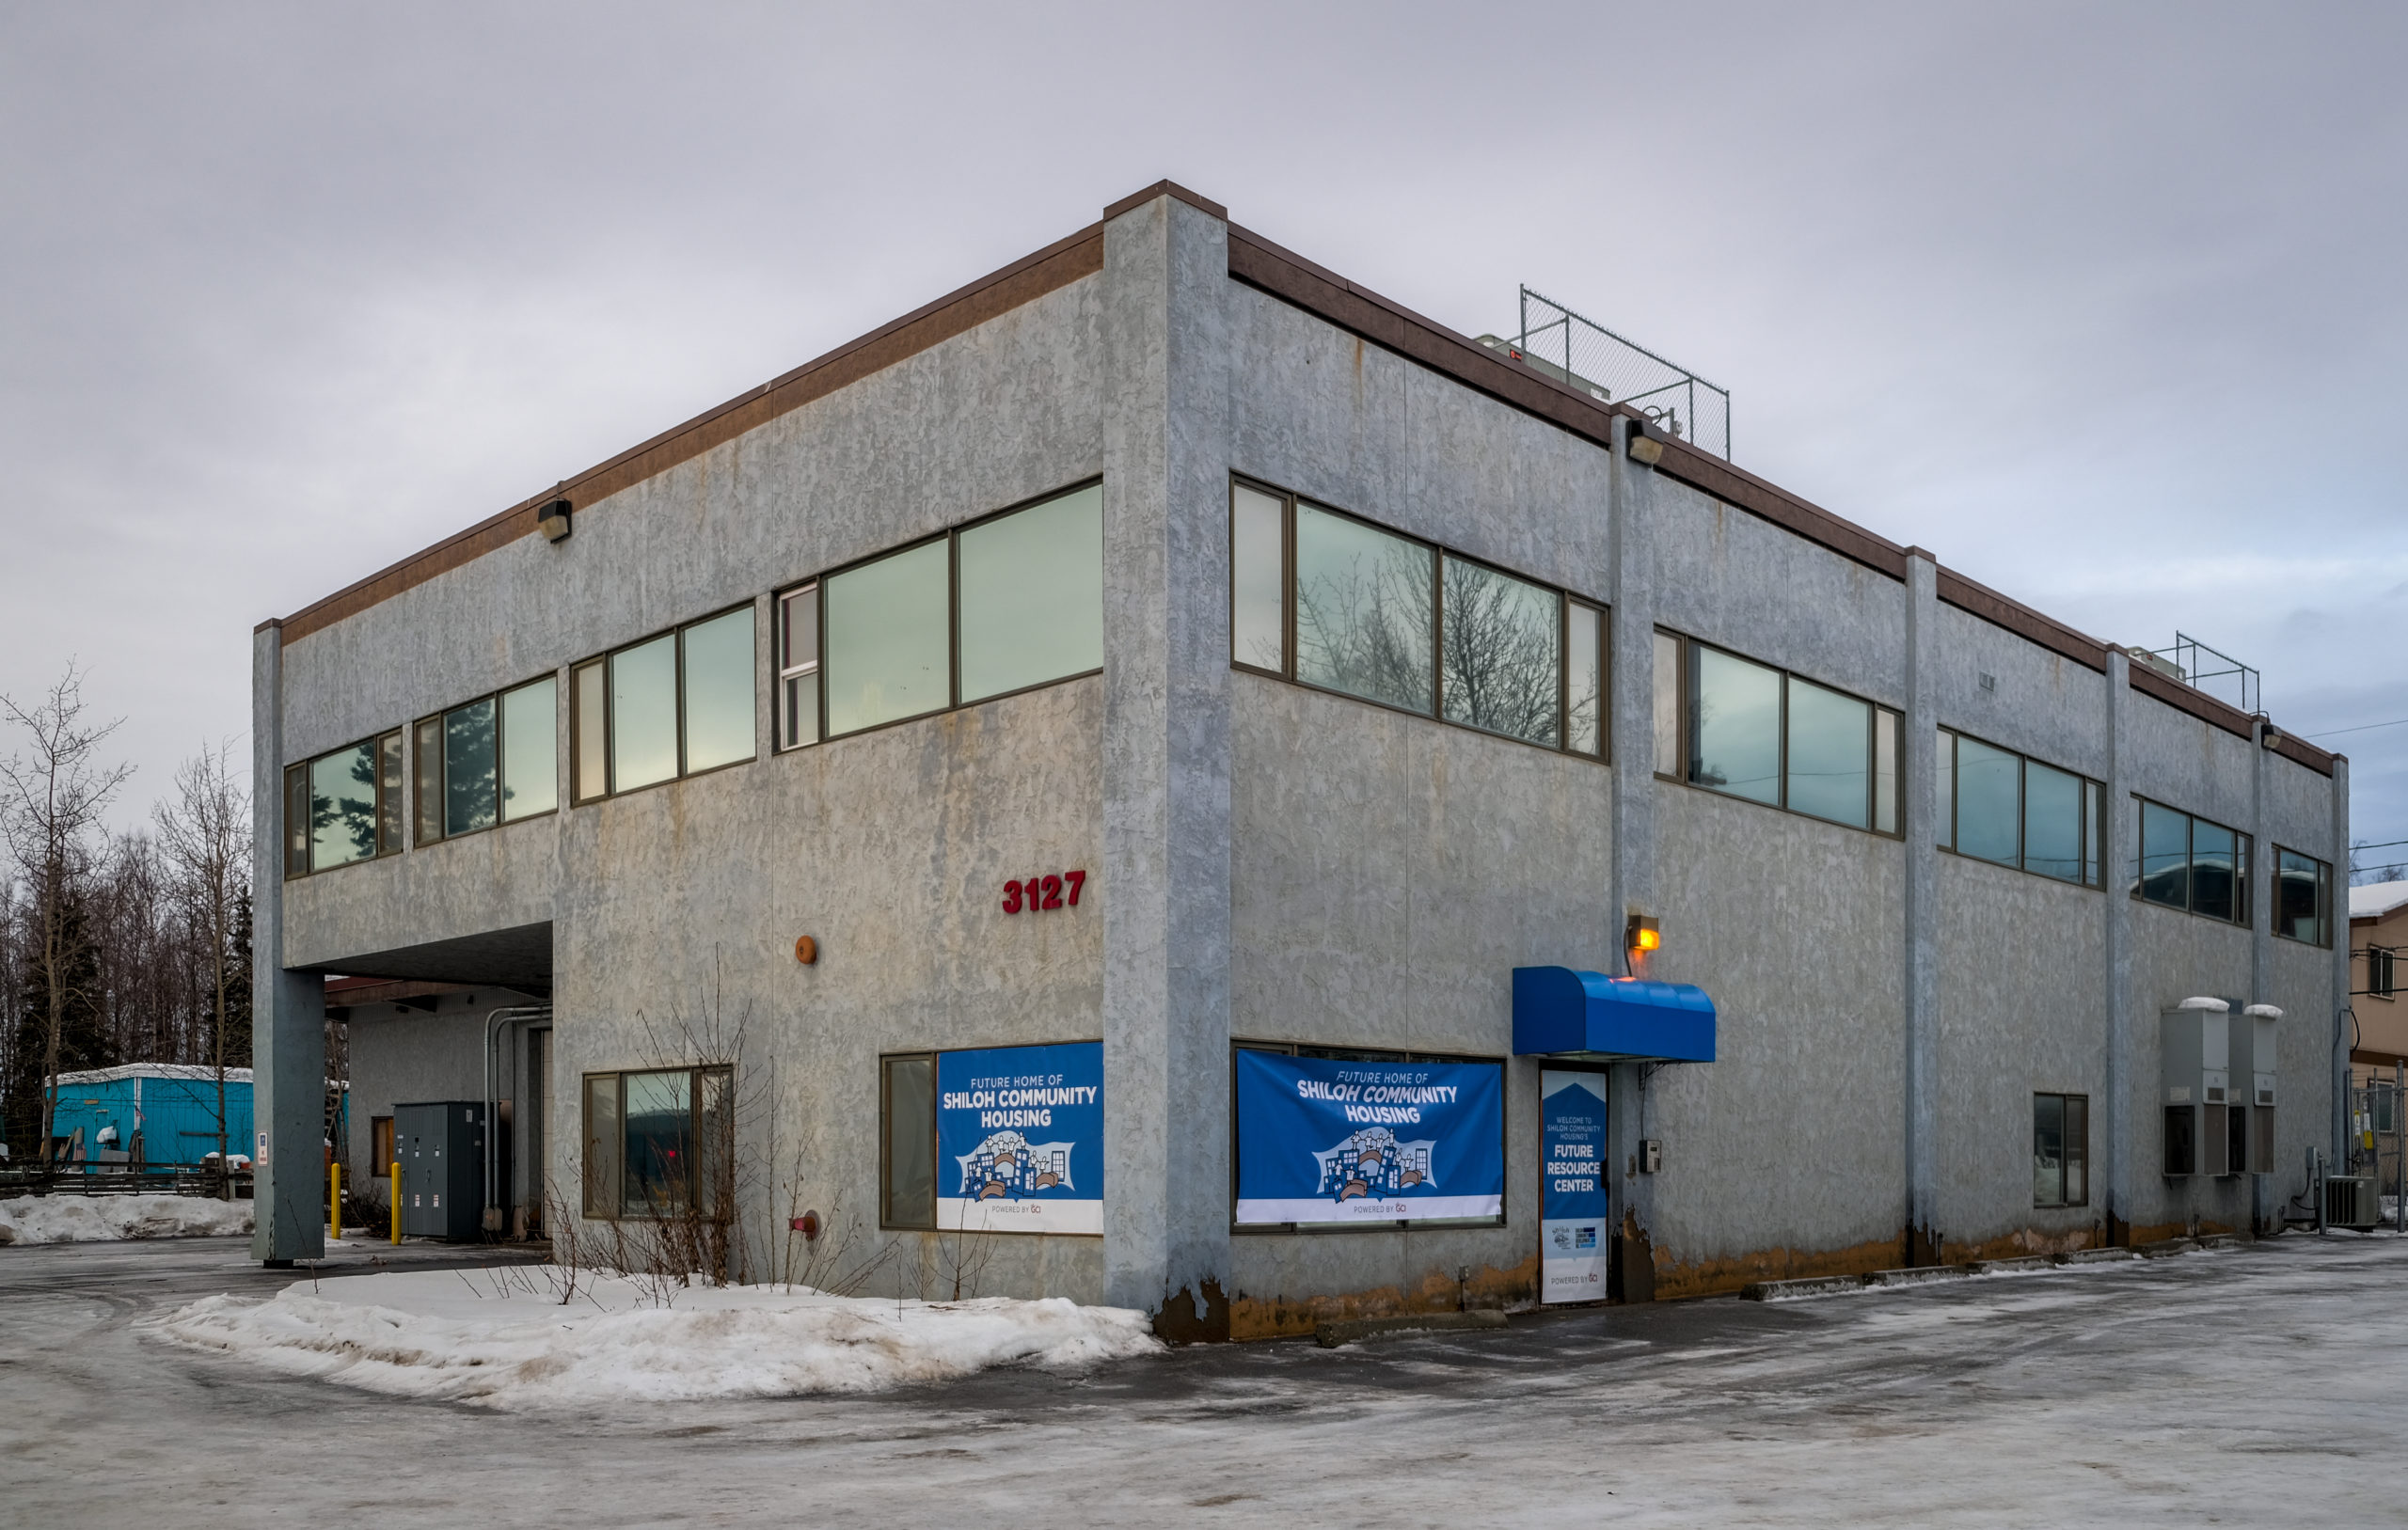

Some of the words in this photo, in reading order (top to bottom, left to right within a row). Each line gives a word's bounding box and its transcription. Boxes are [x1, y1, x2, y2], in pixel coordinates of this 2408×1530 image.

[1002, 870, 1085, 914] 3127
[971, 1076, 1010, 1089] FUTURE
[1014, 1075, 1044, 1087] HOME
[1048, 1074, 1063, 1085] OF
[1336, 1071, 1382, 1083] FUTURE
[1384, 1072, 1412, 1084] HOME
[1415, 1073, 1429, 1084] OF
[943, 1089, 995, 1110] SHILOH
[998, 1086, 1098, 1108] COMMUNITY
[1297, 1080, 1362, 1102] SHILOH
[1364, 1085, 1457, 1104] COMMUNITY
[981, 1109, 1052, 1128] HOUSING
[1345, 1105, 1421, 1124] HOUSING
[1585, 1116, 1592, 1125] TO
[1546, 1124, 1568, 1132] SHILOH
[1569, 1125, 1601, 1133] COMMUNITY
[1560, 1132, 1589, 1141] HOUSING'S
[1554, 1144, 1593, 1158] FUTURE
[1547, 1161, 1601, 1175] RESOURCE
[1554, 1178, 1594, 1192] CENTER
[991, 1205, 1021, 1213] POWERED
[1030, 1205, 1041, 1214] GCI
[1354, 1205, 1385, 1213] POWERED
[1386, 1205, 1394, 1213] BY
[1550, 1275, 1579, 1285] POWERED
[1580, 1275, 1588, 1284] BY
